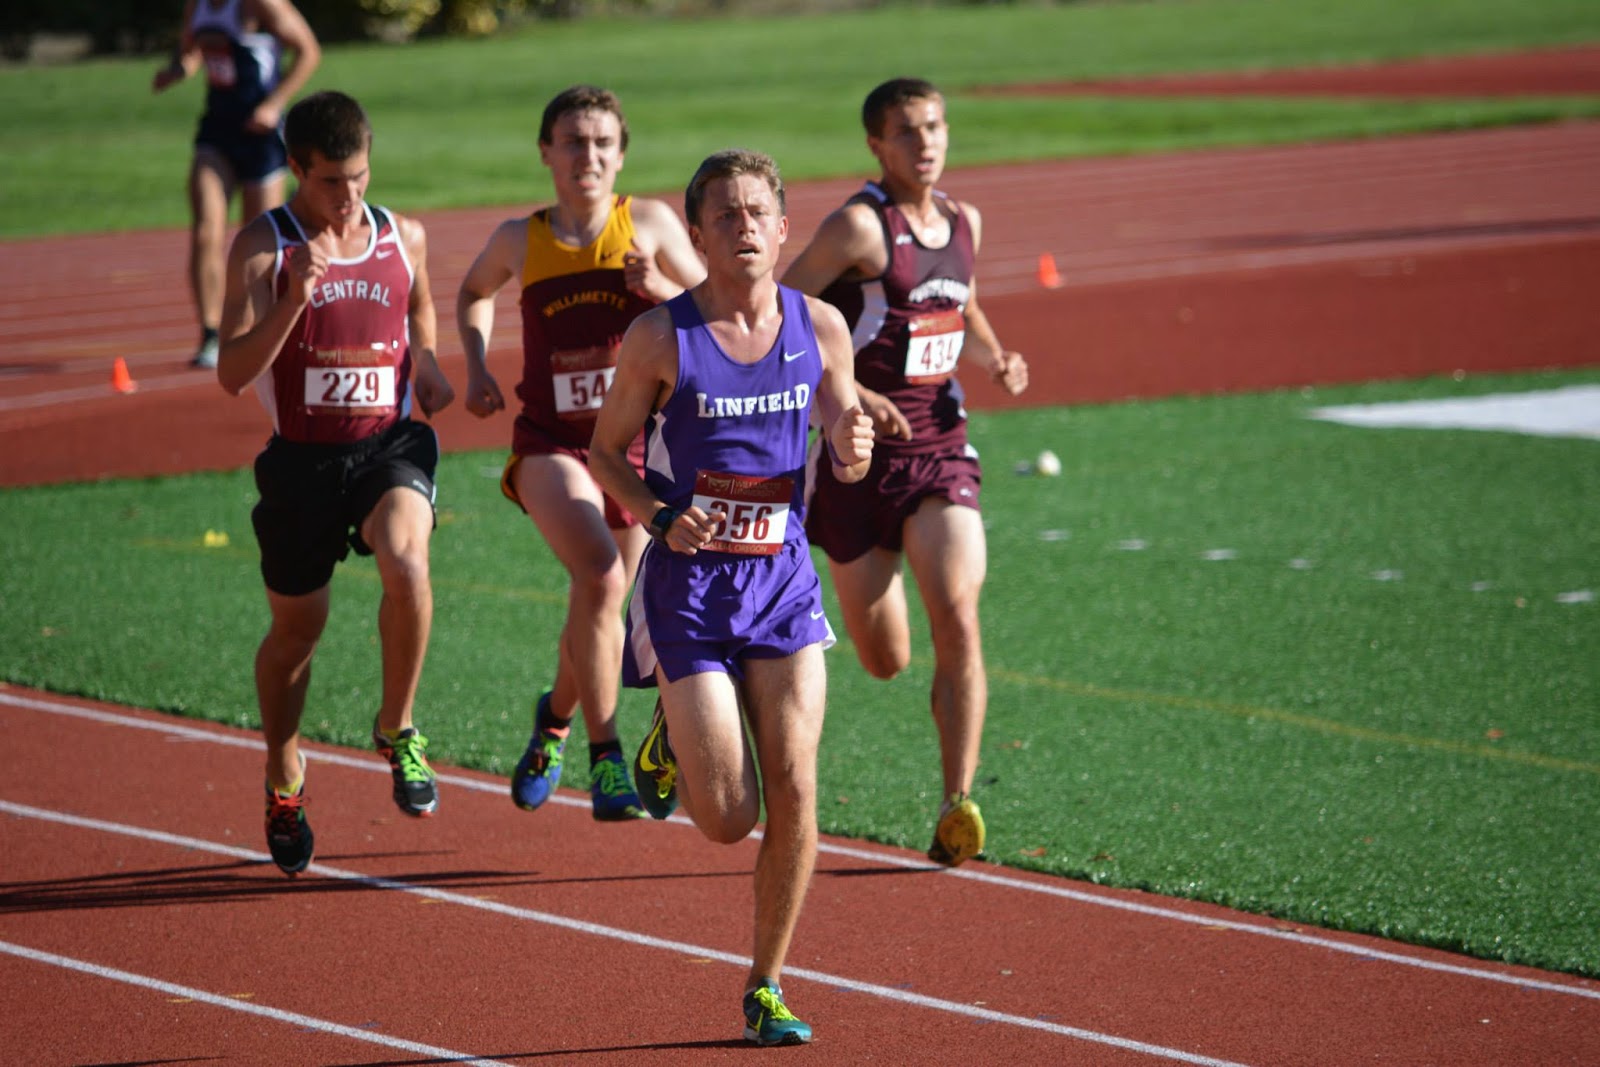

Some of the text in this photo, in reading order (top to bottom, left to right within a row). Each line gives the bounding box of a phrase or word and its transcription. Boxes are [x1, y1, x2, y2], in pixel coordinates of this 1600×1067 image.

[311, 279, 391, 308] CENTRAL
[321, 372, 379, 403] 229
[697, 383, 810, 418] LINFIELD
